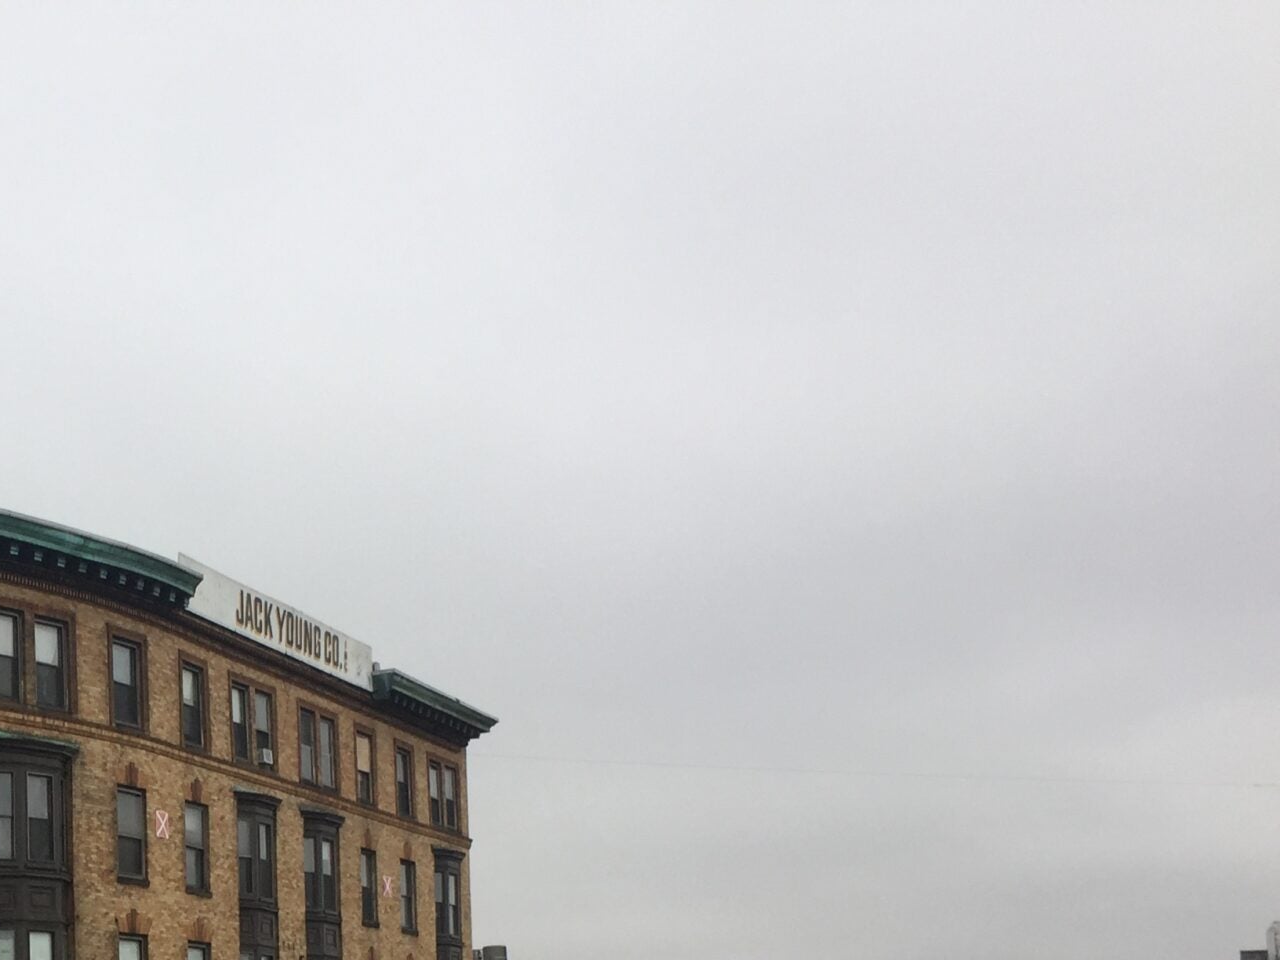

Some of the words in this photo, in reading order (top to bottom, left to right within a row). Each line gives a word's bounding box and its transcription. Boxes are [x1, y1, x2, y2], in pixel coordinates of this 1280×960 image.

[236, 589, 273, 638] JACK
[276, 606, 322, 660] YOUNG
[323, 631, 343, 671] CO.
